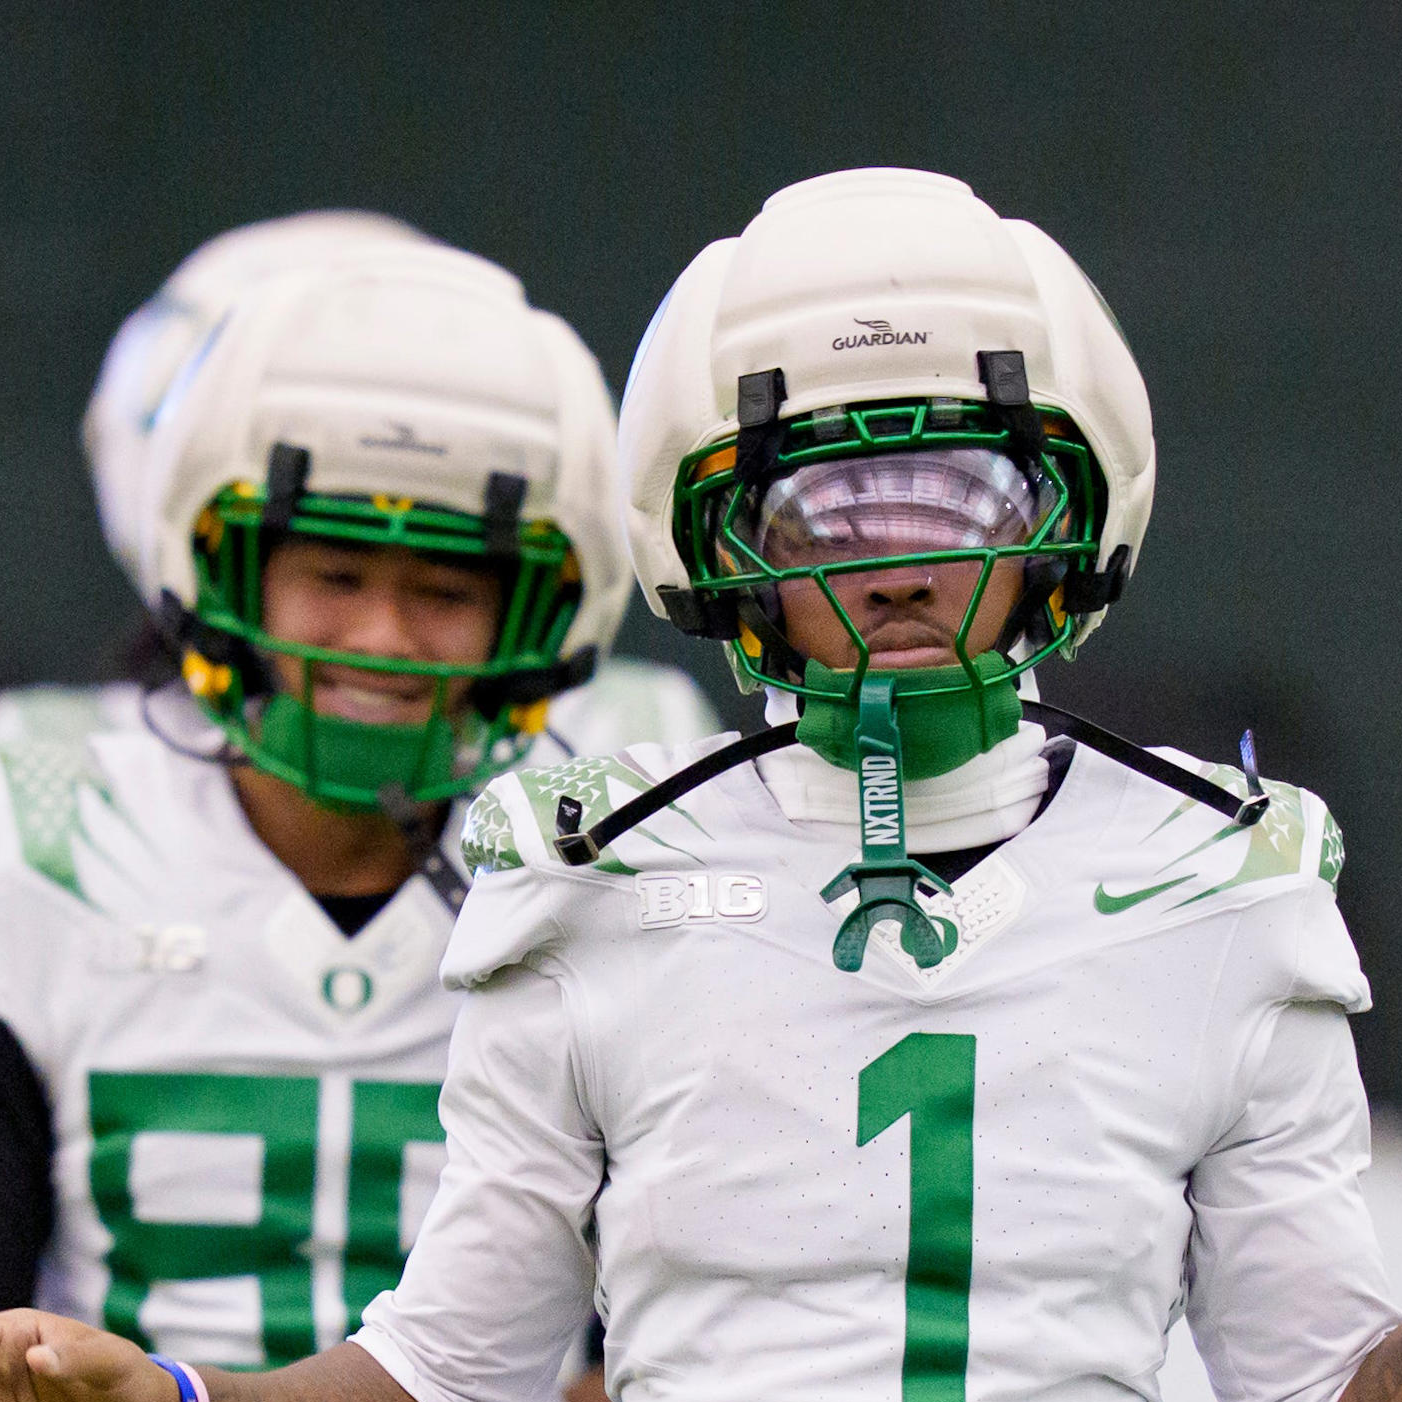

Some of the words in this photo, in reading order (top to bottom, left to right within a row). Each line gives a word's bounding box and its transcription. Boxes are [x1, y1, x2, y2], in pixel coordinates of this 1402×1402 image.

[831, 331, 927, 351] GUARDIAN
[861, 755, 900, 846] NXTRND
[321, 964, 375, 1015] O
